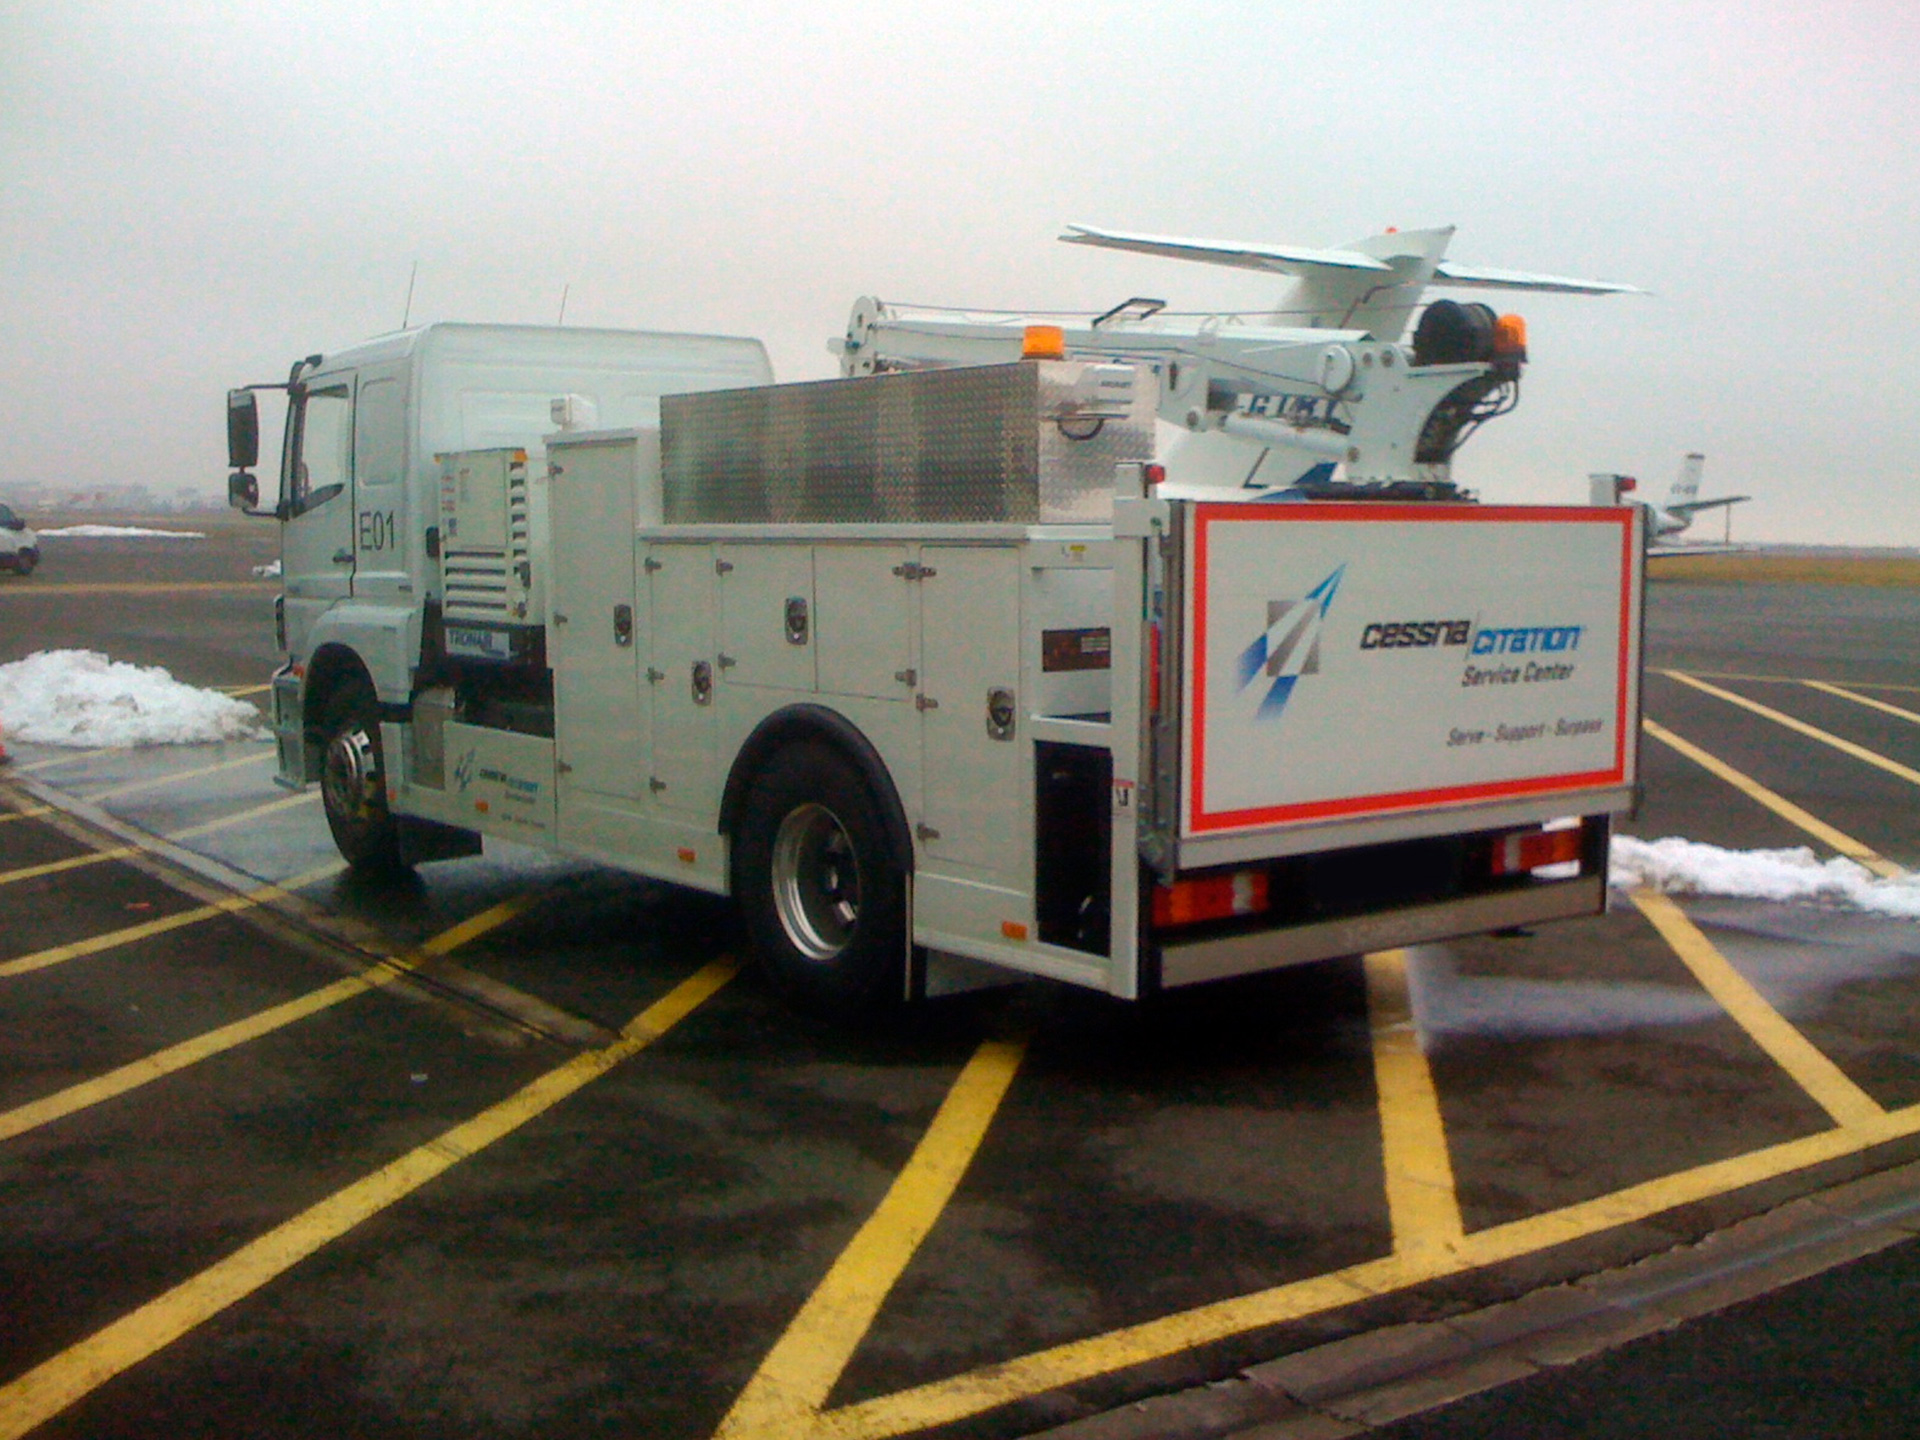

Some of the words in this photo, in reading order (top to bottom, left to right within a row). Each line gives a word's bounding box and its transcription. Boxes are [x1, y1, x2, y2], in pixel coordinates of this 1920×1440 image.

[358, 511, 395, 551] E01
[1461, 664, 1520, 687] Service
[1523, 660, 1574, 683] Center
